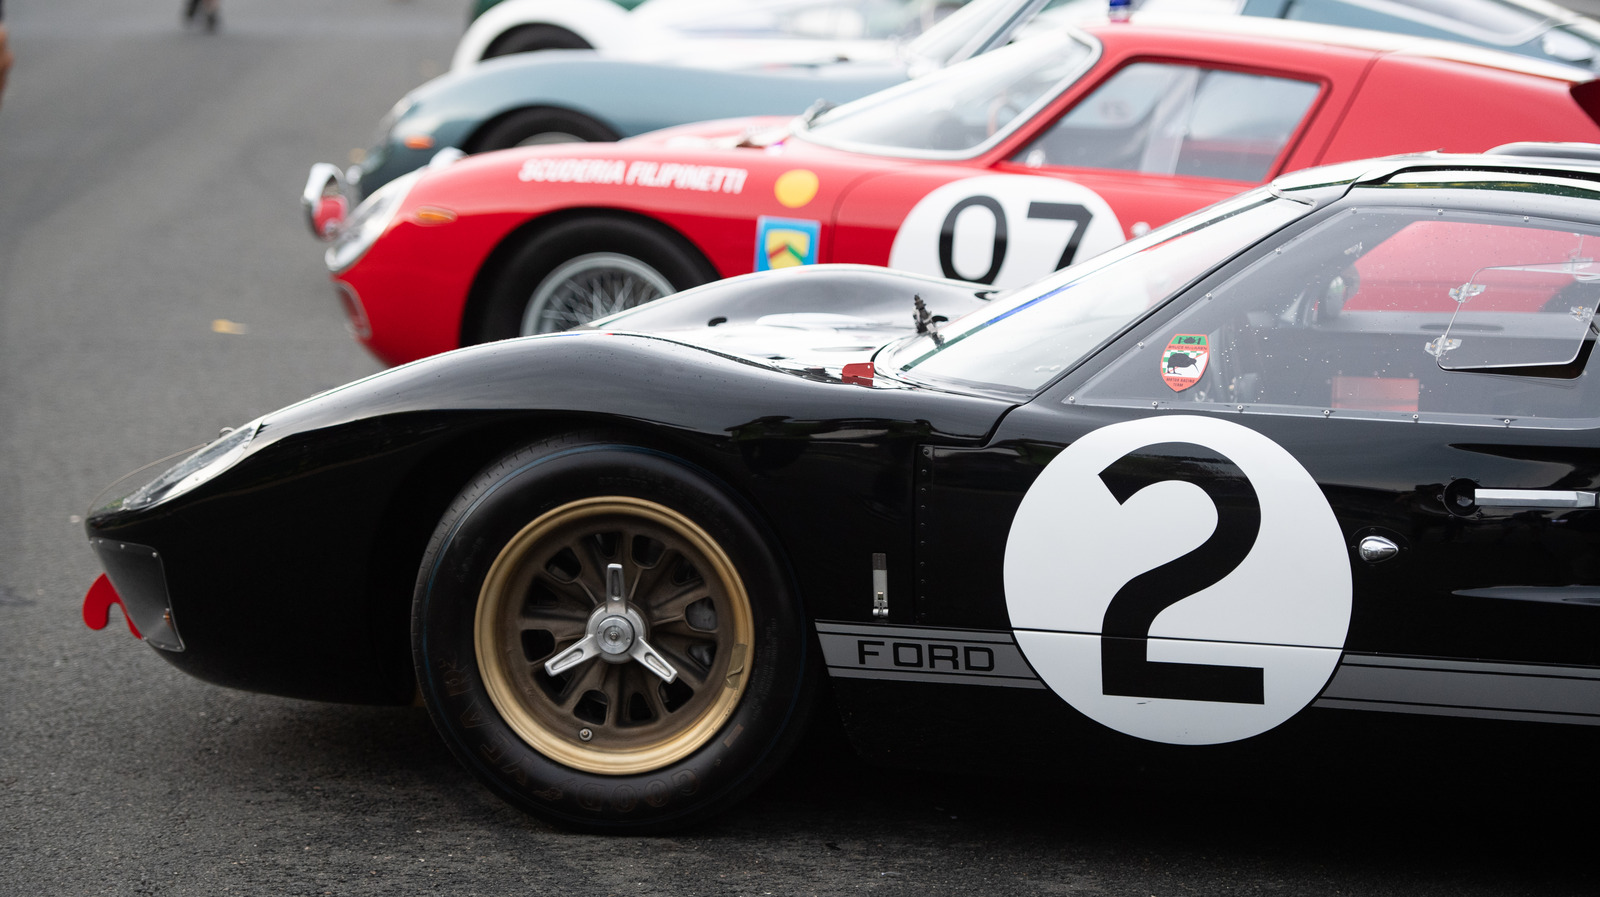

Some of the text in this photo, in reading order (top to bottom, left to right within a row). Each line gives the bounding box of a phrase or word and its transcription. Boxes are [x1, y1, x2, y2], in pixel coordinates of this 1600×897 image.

[518, 158, 748, 194] SCUDERIA FILIPINETTI
[938, 194, 1093, 284] 07
[1097, 441, 1265, 705] 2
[857, 640, 995, 672] FORD
